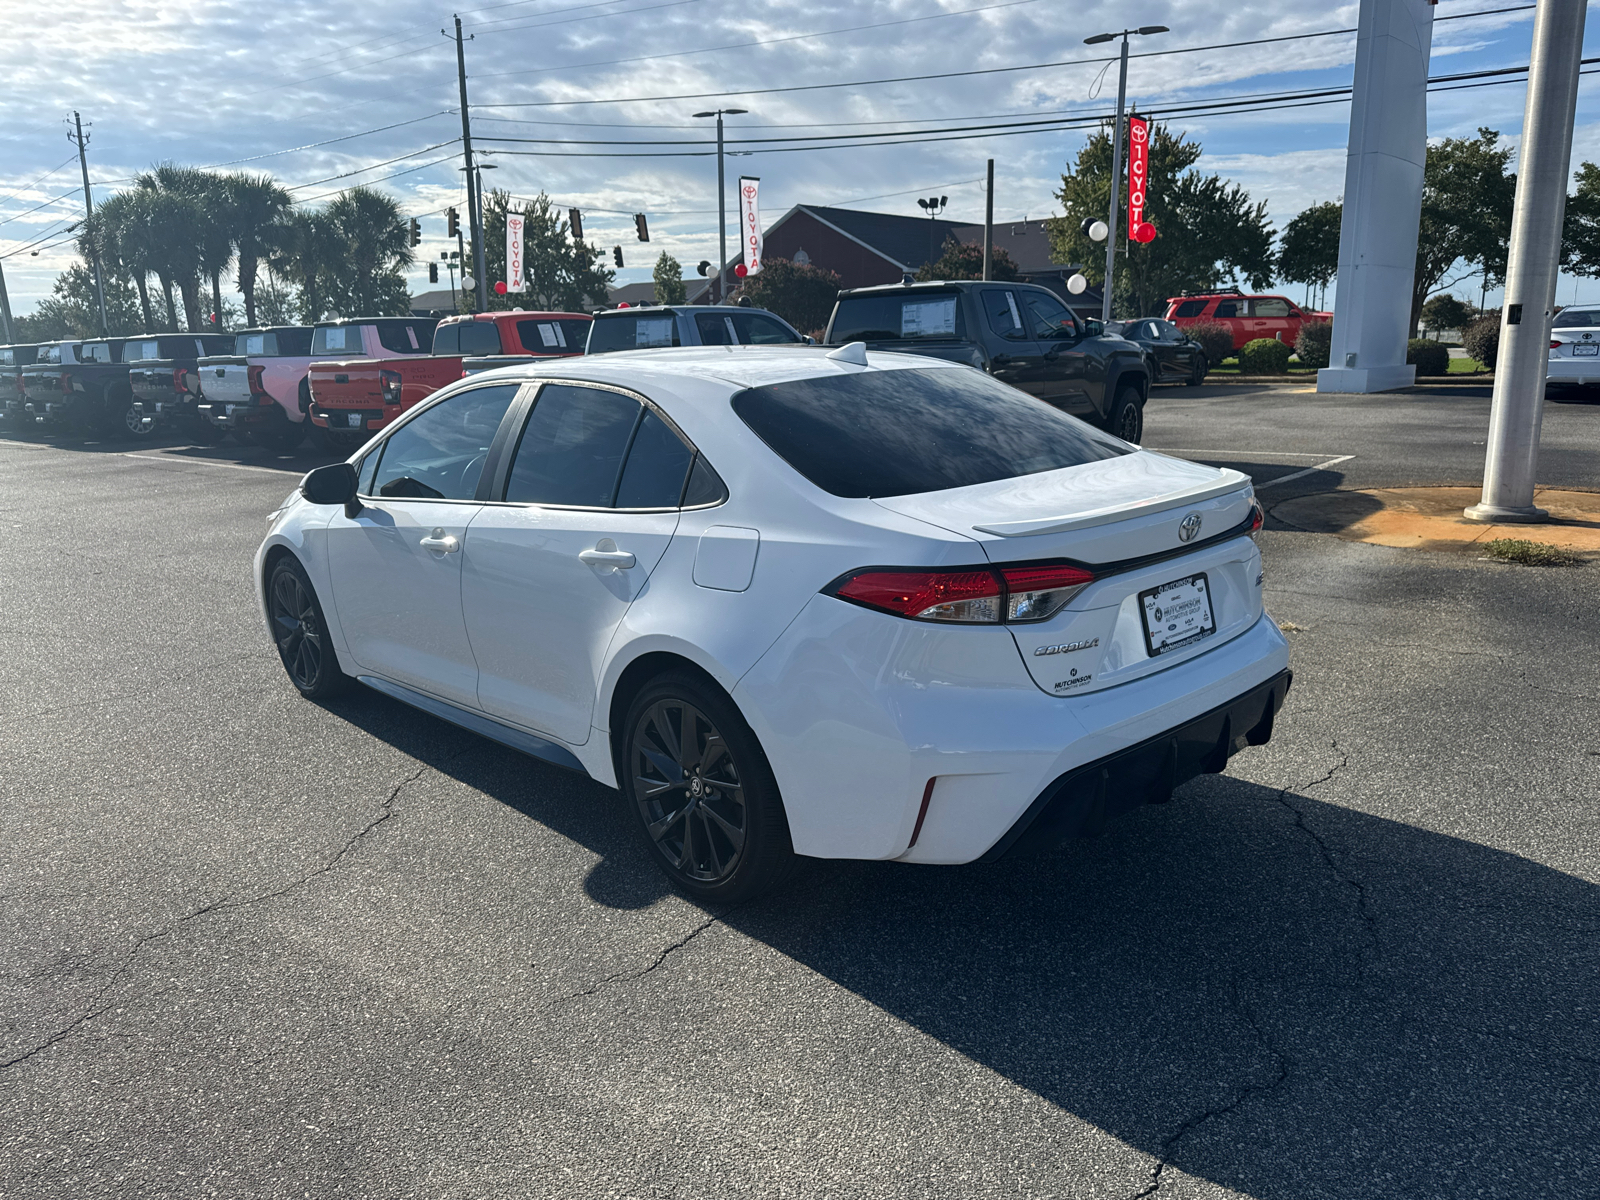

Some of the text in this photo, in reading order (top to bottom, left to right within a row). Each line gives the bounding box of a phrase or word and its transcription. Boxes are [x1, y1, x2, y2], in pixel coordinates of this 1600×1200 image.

[1132, 145, 1143, 233] TOYOT
[747, 201, 758, 269] TOYOTA
[512, 231, 520, 287] TOYOTA
[1164, 578, 1193, 591] HUTCHINSON
[1164, 597, 1201, 617] HUTCHINSON
[1165, 606, 1201, 623] AUTOMOTIVE GROUP
[1034, 637, 1100, 656] COROLLA
[1054, 674, 1092, 689] HUTCHINSON
[1055, 684, 1079, 693] AUTOMOTIVE
